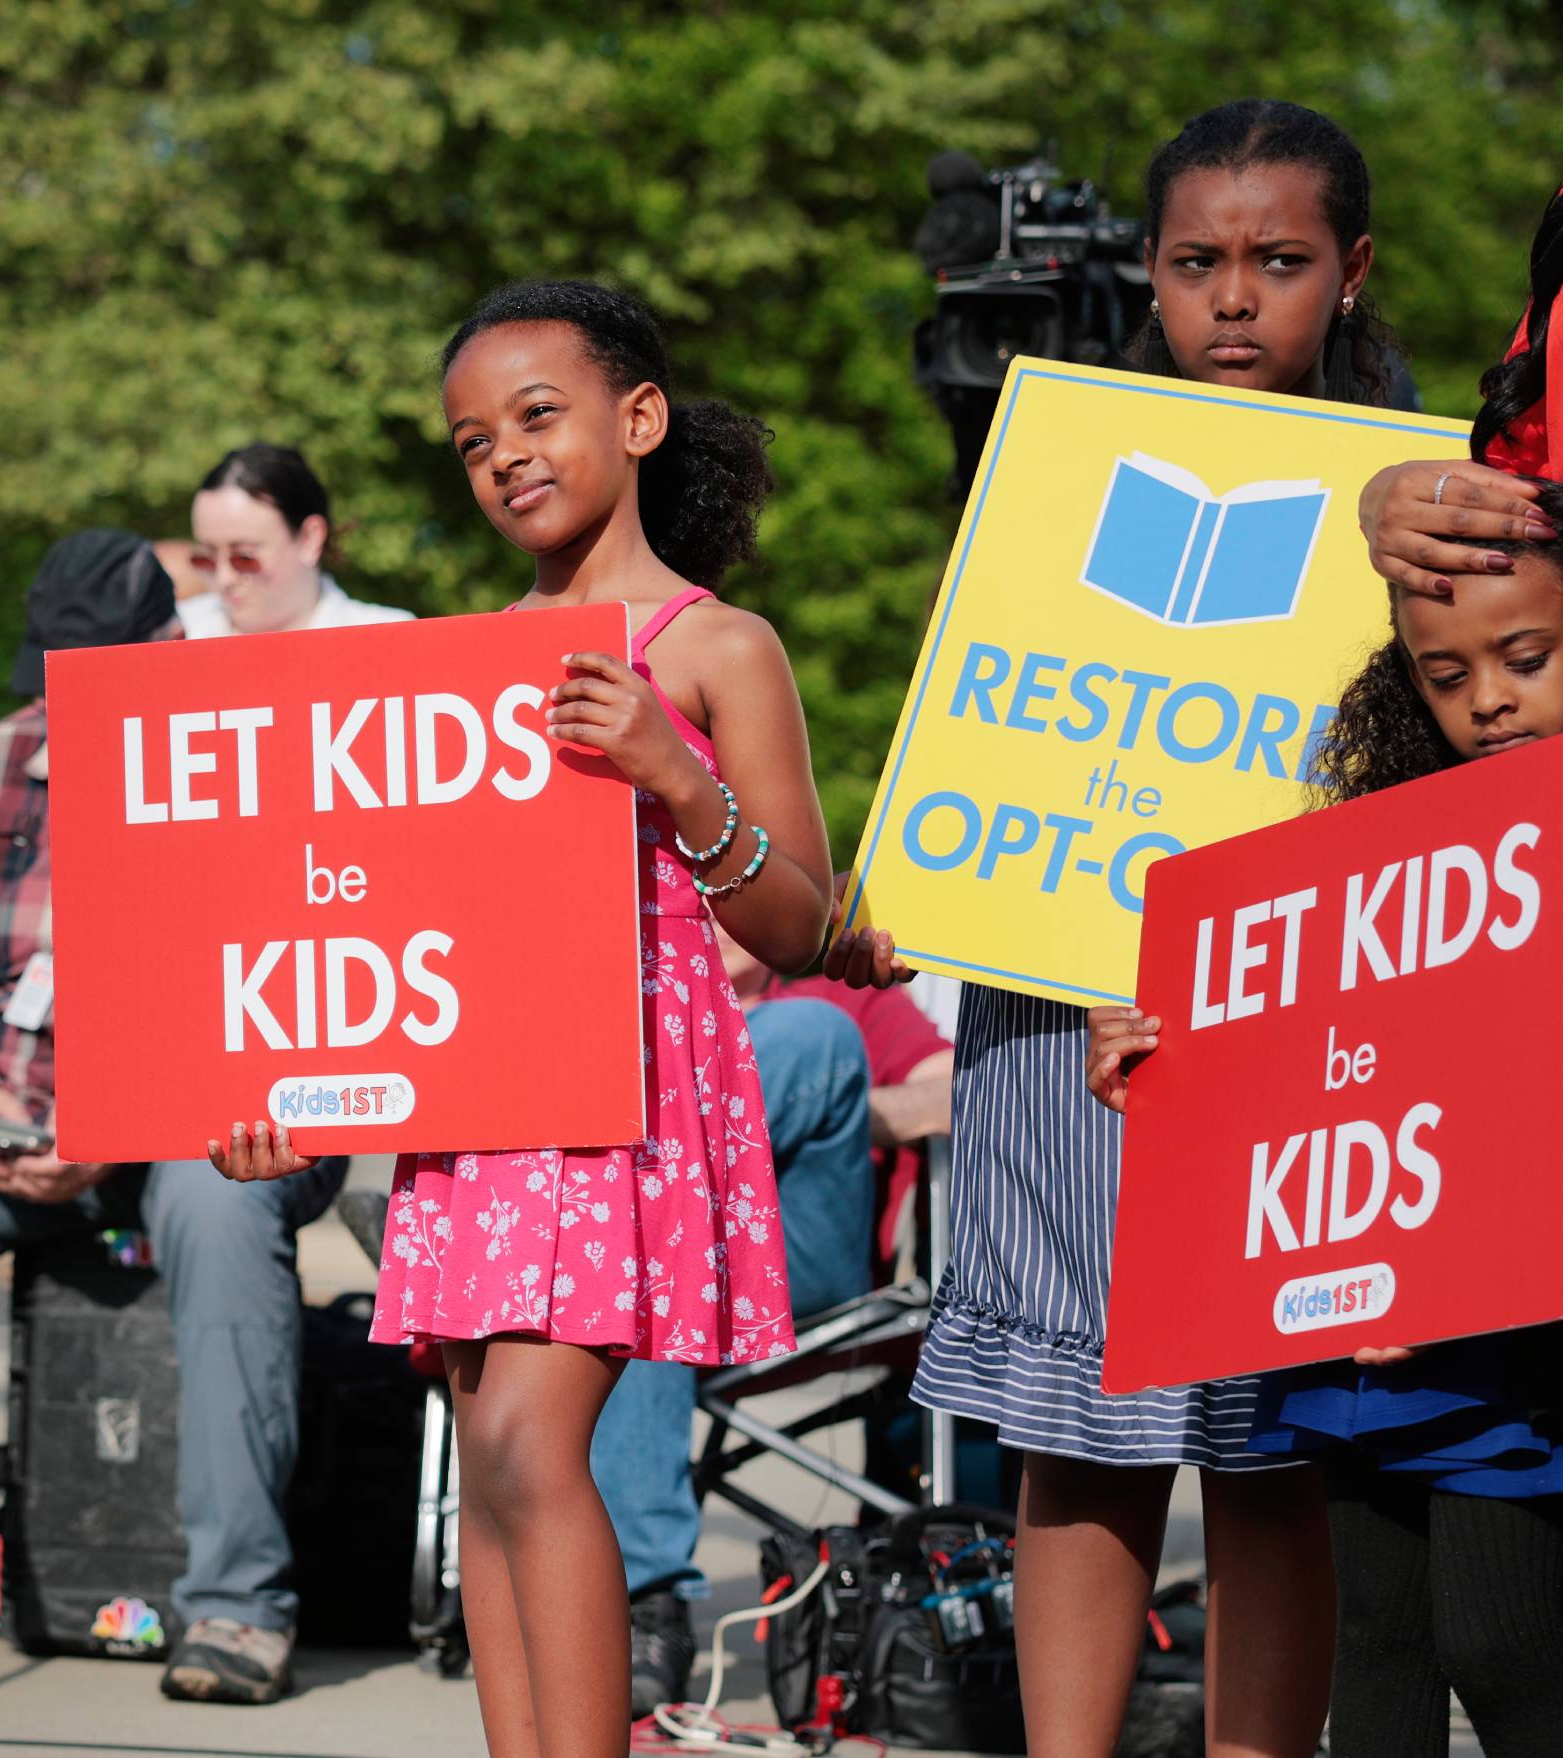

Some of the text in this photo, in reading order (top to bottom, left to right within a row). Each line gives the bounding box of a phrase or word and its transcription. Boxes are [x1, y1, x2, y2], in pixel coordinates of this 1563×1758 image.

[124, 684, 552, 824] LET KIDS
[1085, 760, 1163, 818] the
[305, 844, 368, 905] be
[1191, 823, 1542, 1030] LET KIDS
[223, 930, 460, 1053] KIDS
[1325, 1027, 1377, 1091] be
[1245, 1103, 1443, 1260] KIDS
